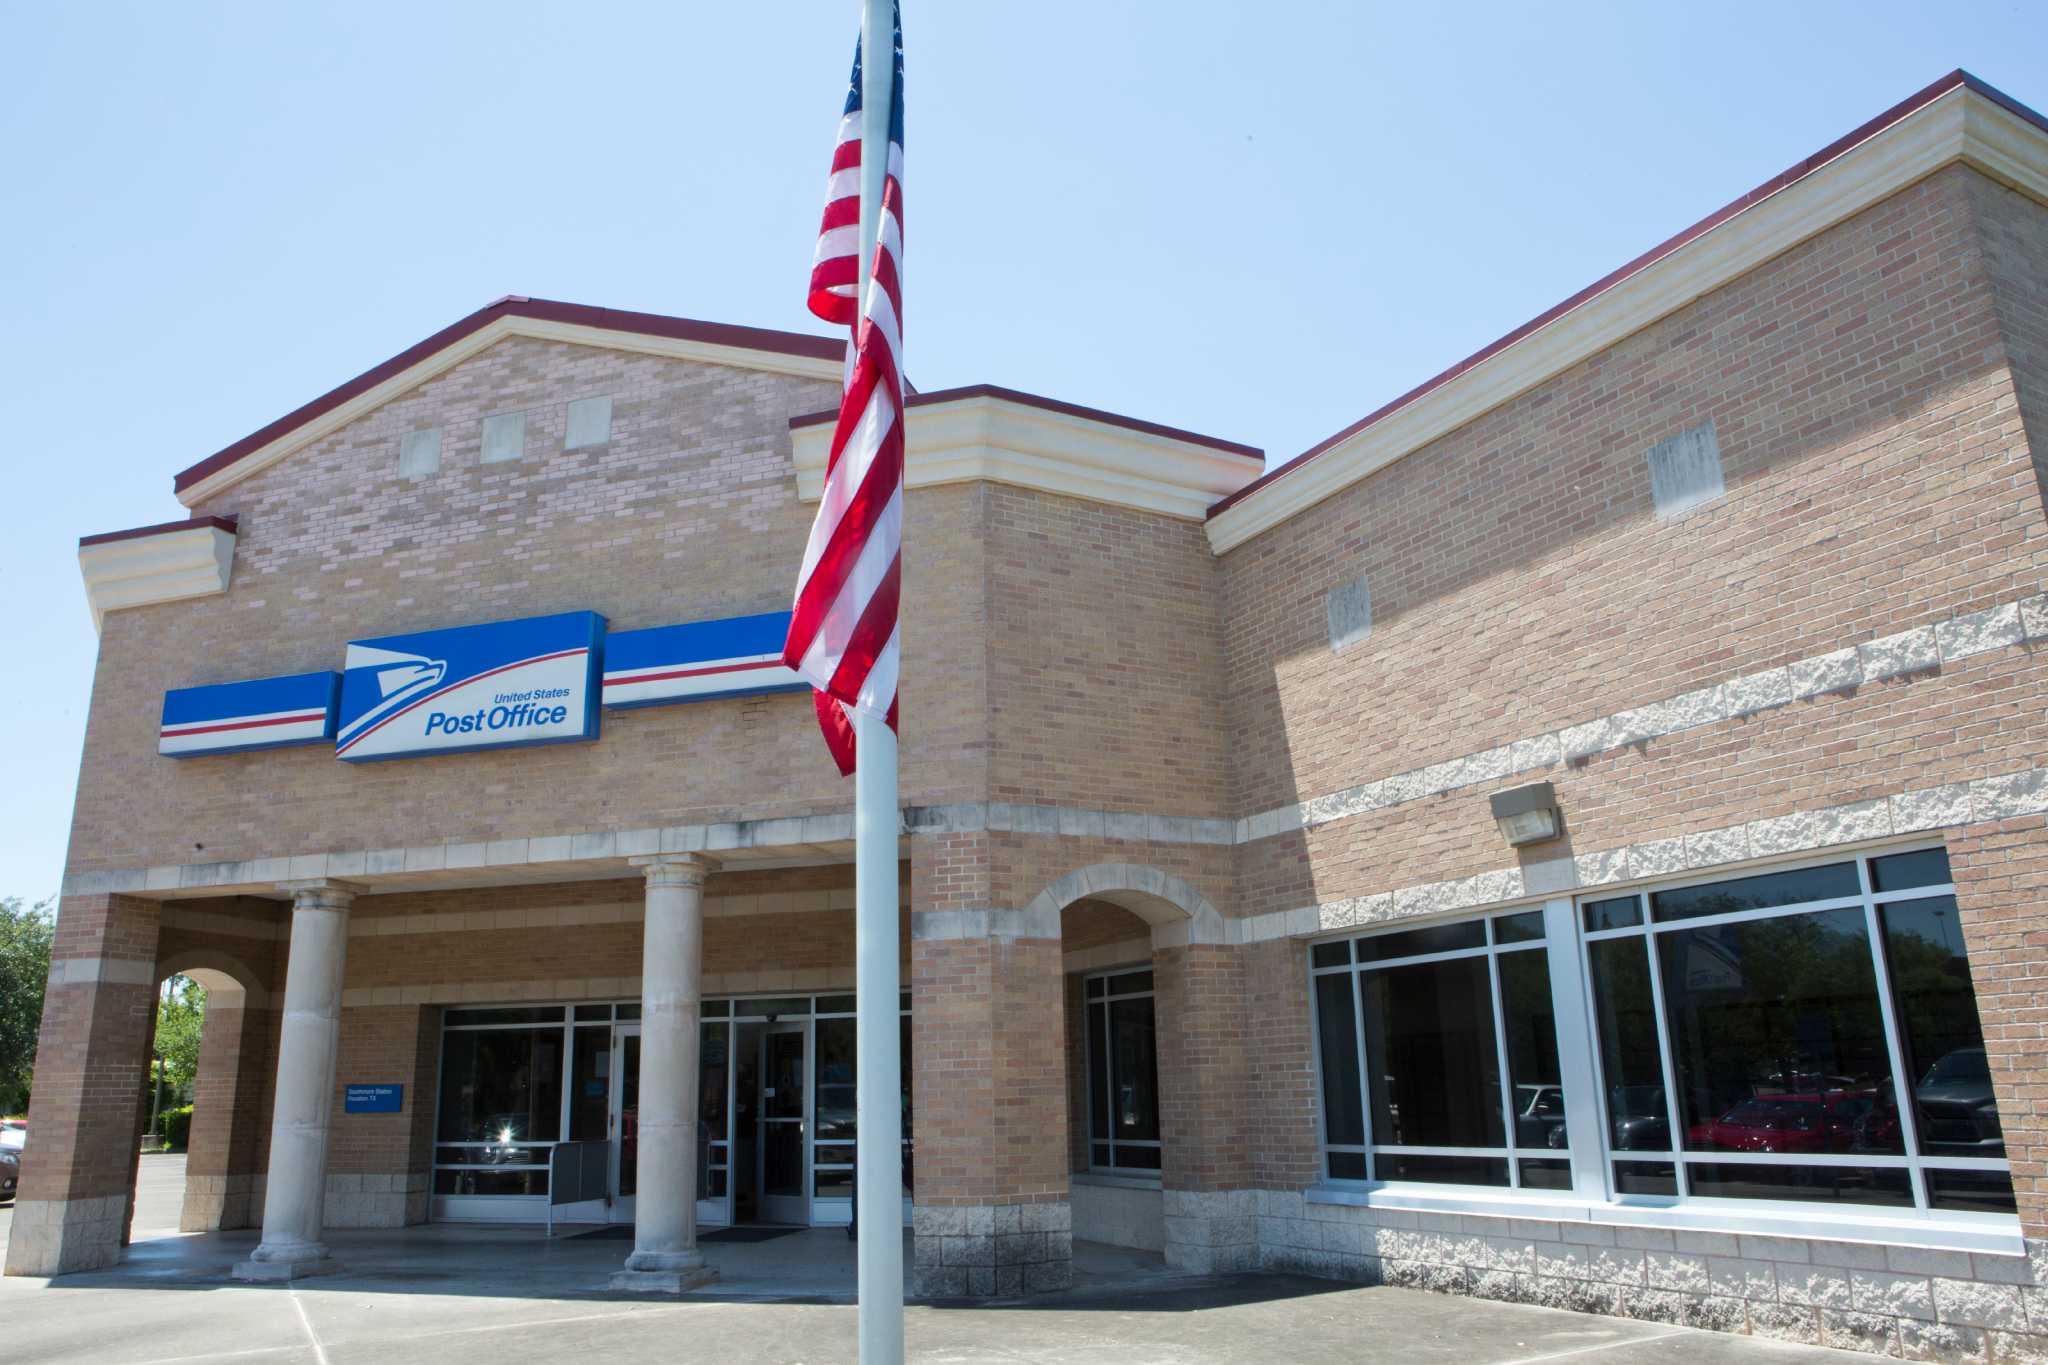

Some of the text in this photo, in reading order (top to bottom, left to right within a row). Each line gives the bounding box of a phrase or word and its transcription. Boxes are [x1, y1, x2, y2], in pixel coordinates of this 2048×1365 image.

[494, 687, 570, 704] United States
[425, 703, 567, 736] Post Office
